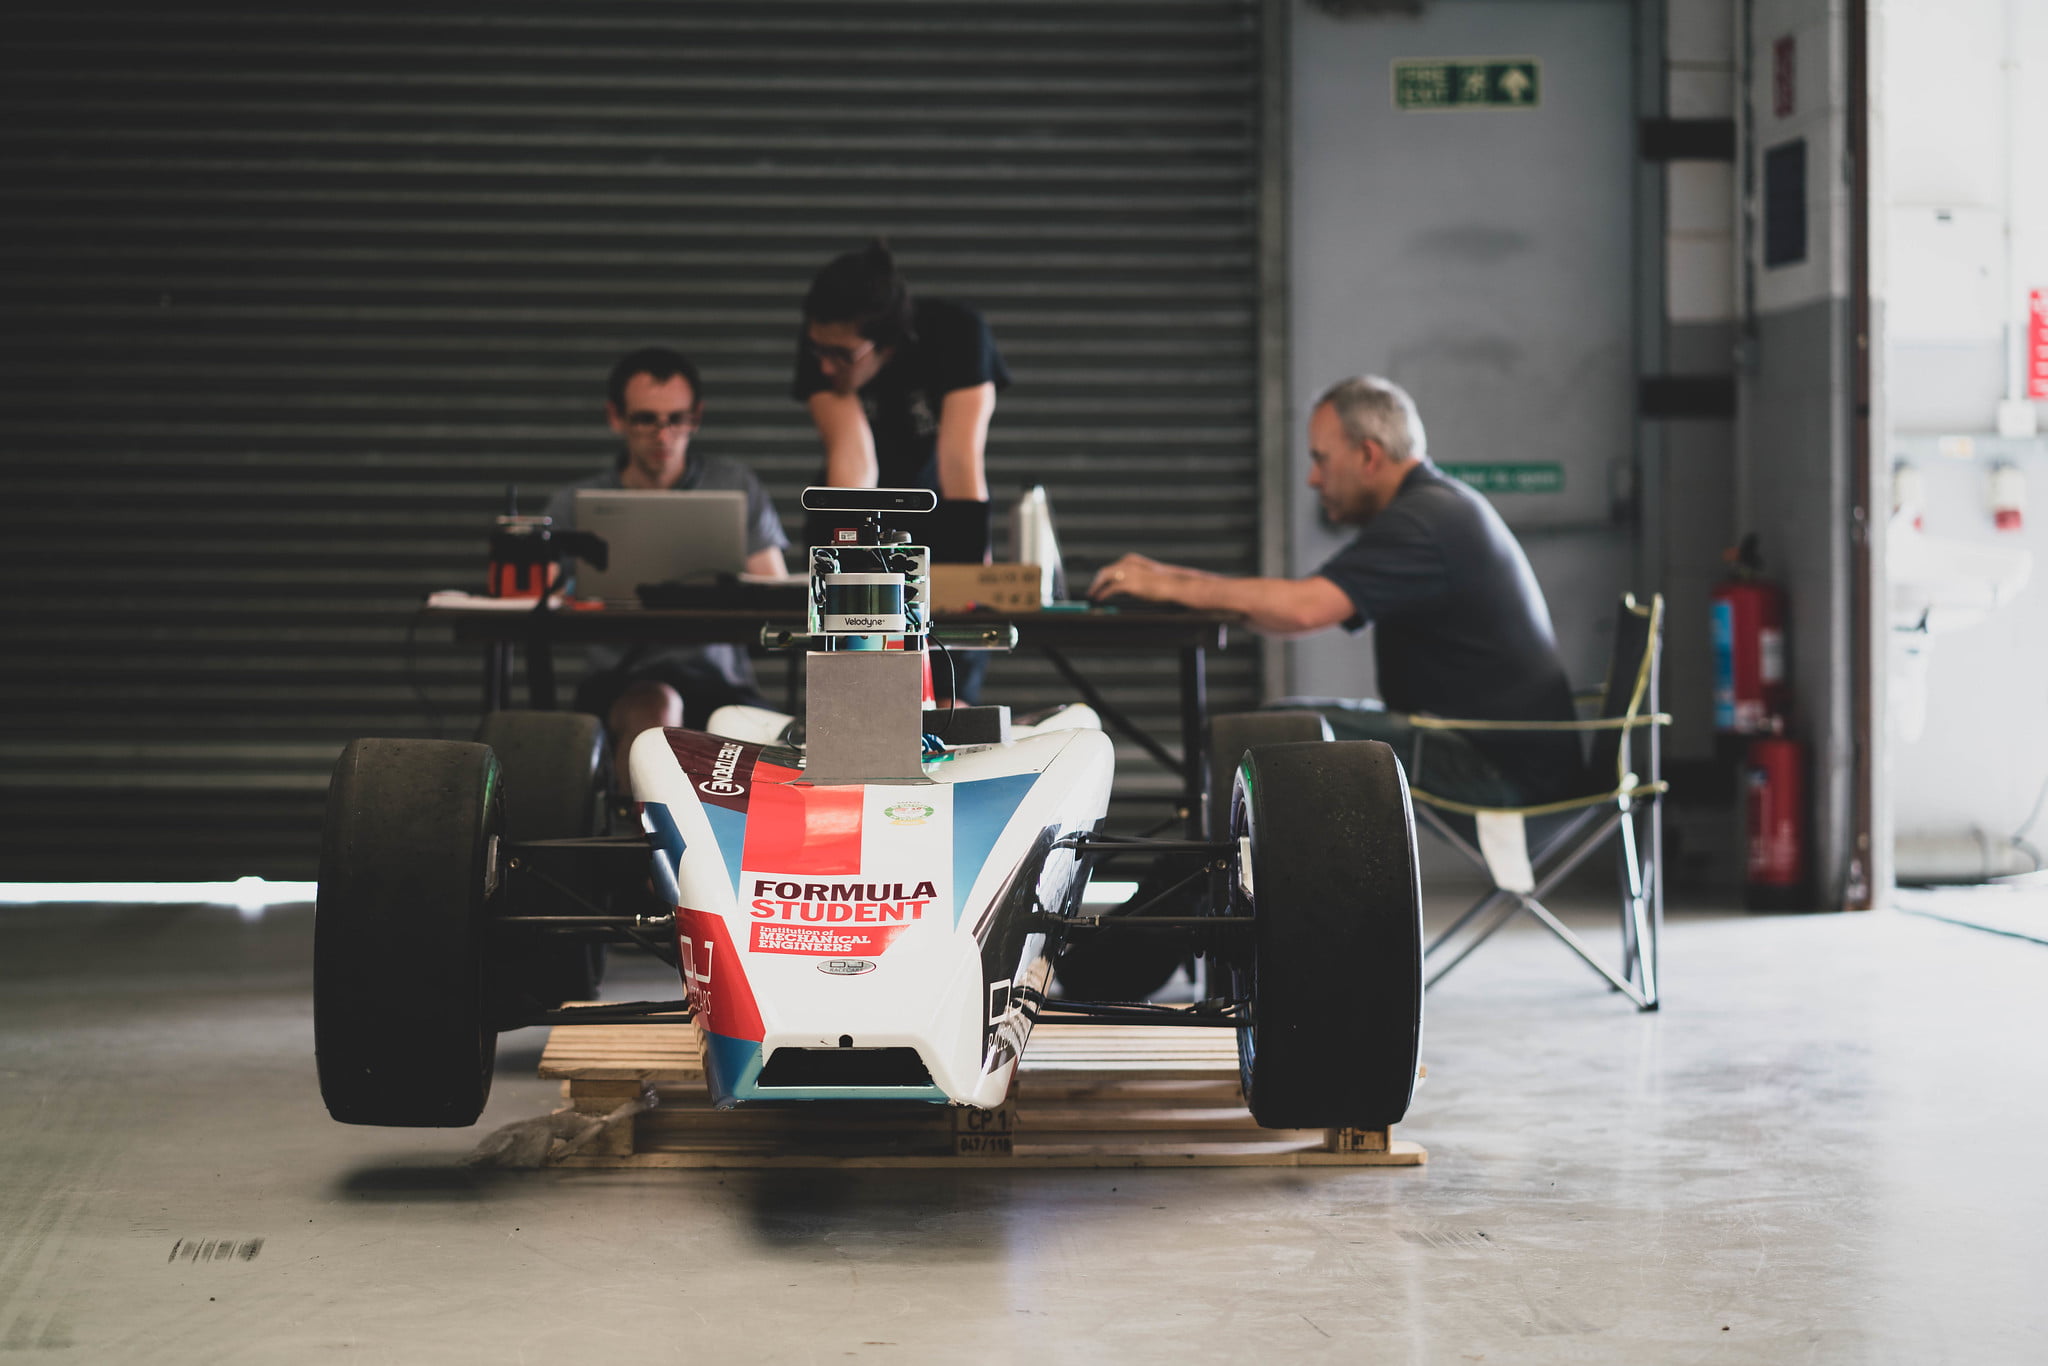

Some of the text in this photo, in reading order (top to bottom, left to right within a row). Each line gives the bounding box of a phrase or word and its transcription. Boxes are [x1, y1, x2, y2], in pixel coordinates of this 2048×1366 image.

[845, 617, 883, 628] Velodyne
[754, 880, 938, 902] FORMULA
[750, 899, 931, 923] STUDENT
[760, 925, 821, 936] Institution
[759, 932, 871, 944] MECHANICAL
[758, 939, 853, 952] ENGINEERS
[967, 1109, 1007, 1130] CP 1
